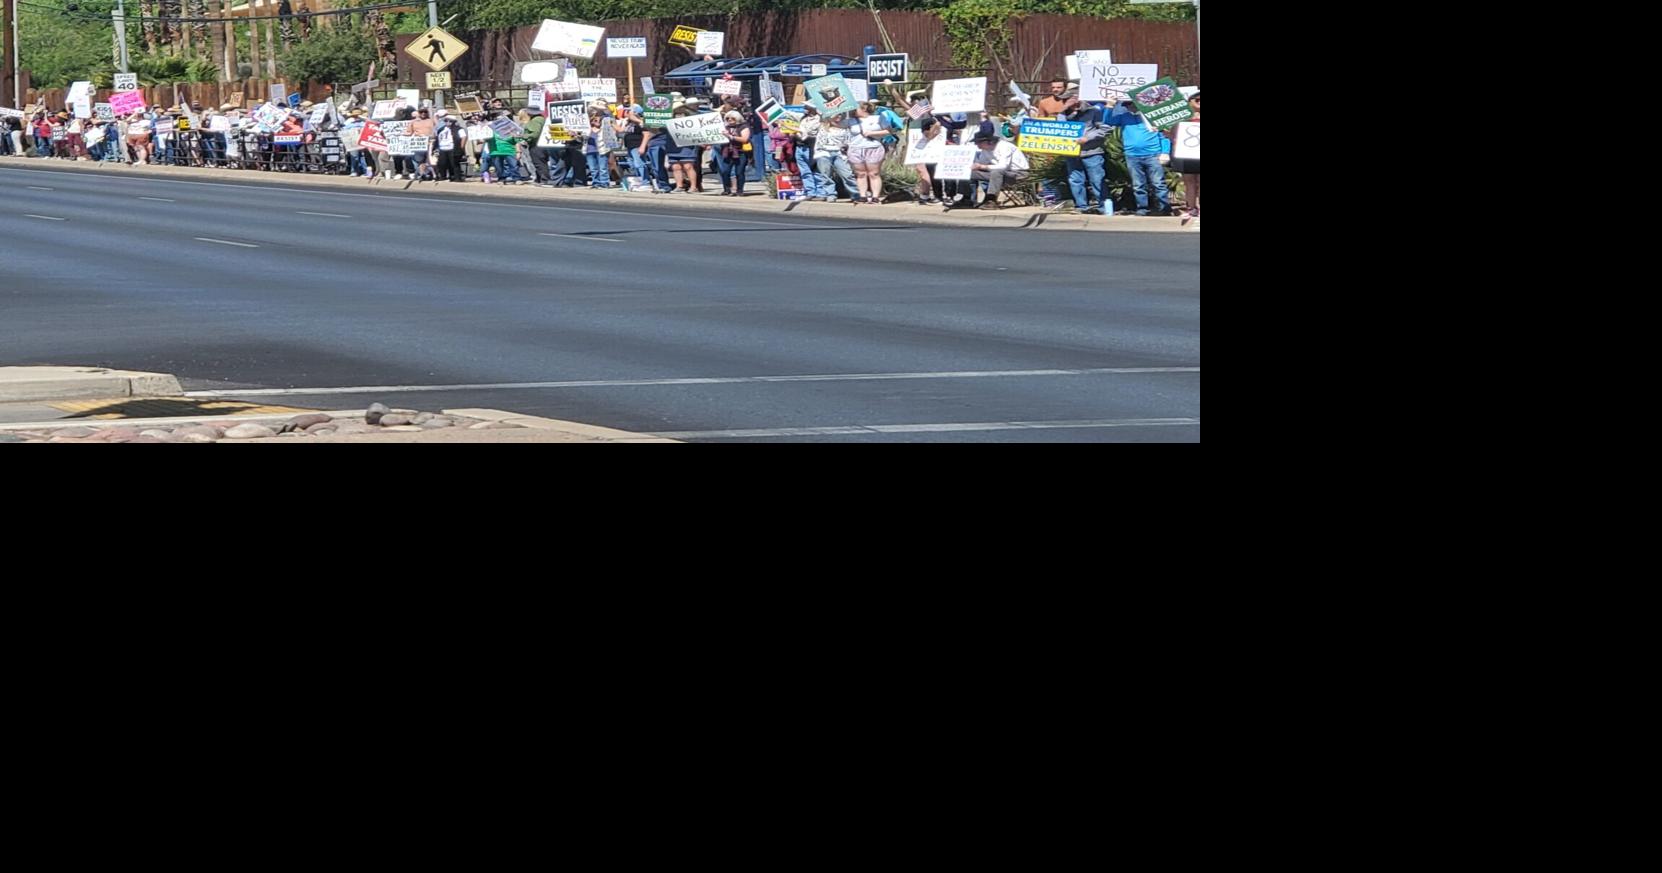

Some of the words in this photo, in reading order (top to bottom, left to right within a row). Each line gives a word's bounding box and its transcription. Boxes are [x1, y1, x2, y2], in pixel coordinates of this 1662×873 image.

[870, 60, 904, 77] RESIST
[1092, 65, 1119, 78] NO
[1099, 77, 1146, 86] NAZIS
[550, 105, 584, 119] RESIST
[1145, 100, 1188, 119] VETERANS
[674, 119, 694, 130] NO
[1153, 109, 1192, 127] HEROES
[1025, 126, 1079, 137] TRUMPERS
[1020, 141, 1077, 151] ZELENSKY
